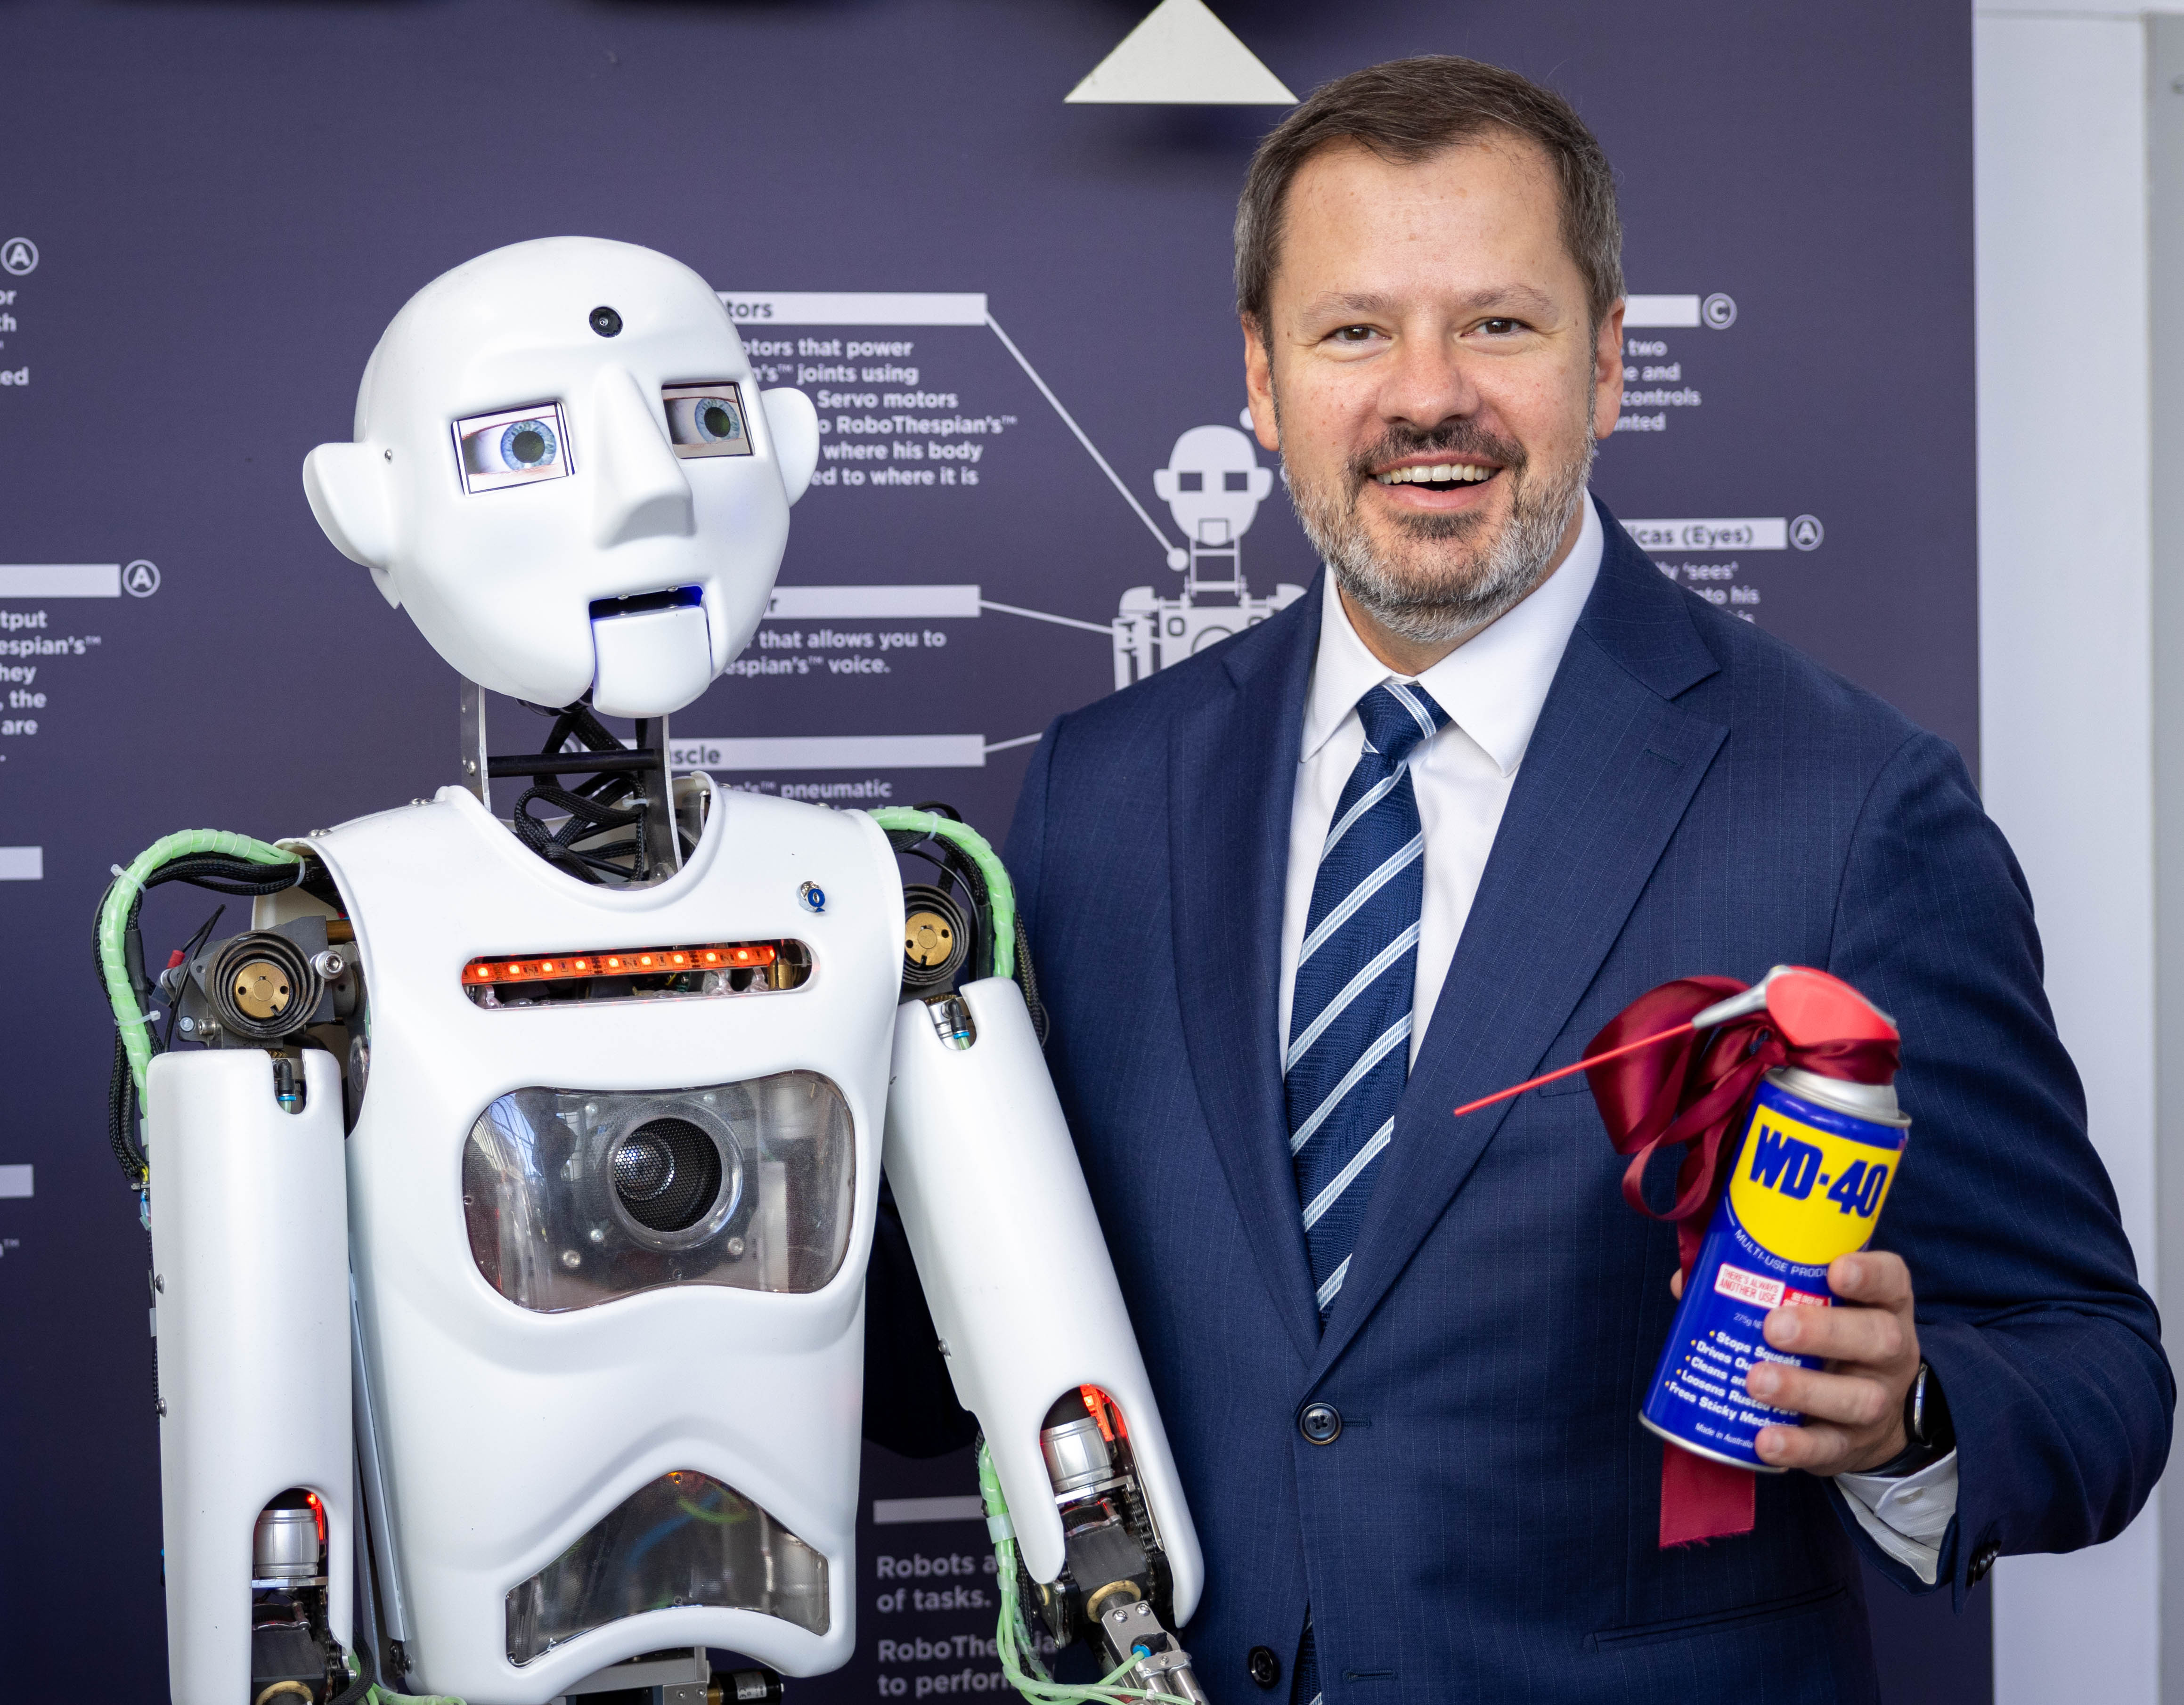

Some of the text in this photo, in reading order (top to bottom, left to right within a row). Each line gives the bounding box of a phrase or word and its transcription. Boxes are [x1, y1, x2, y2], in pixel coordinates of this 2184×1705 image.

[0, 313, 17, 332] h
[798, 338, 842, 357] that
[847, 341, 913, 359] power
[1629, 339, 1668, 357] two
[796, 363, 857, 385] joints
[861, 364, 919, 386] using
[1642, 362, 1681, 382] and
[817, 390, 958, 408] Servo motors
[1621, 387, 1702, 406] controls
[822, 440, 983, 463] where his body
[842, 467, 865, 486] to
[870, 466, 936, 486] where
[940, 466, 957, 486] it
[961, 466, 980, 486] is
[1683, 525, 1753, 549] (Eyes)
[1730, 585, 1761, 604] his
[758, 629, 947, 651] that allows you to
[828, 655, 892, 674] voice.
[9, 689, 47, 708] the
[1, 720, 38, 735] are
[670, 746, 720, 764] scle
[780, 779, 893, 799] pneumatic
[1749, 1123, 1889, 1218] WD-40
[1735, 1228, 1789, 1273] MULTI-USE
[1719, 1278, 1757, 1299] ANOTHER
[1759, 1290, 1777, 1305] USE
[1733, 1313, 1752, 1327] 275g
[1695, 1340, 1752, 1372] Drives Ou
[1716, 1332, 1802, 1367] Stops Squeaks
[1690, 1356, 1728, 1380] Cleans
[1681, 1370, 1726, 1397] Loosens
[1669, 1381, 1697, 1403] Frees
[1699, 1396, 1737, 1421] Sticky
[1695, 1422, 1754, 1449] Made in Australia
[877, 1554, 976, 1579] Robots
[876, 1585, 992, 1613] of tasks.
[878, 1674, 908, 1697] to
